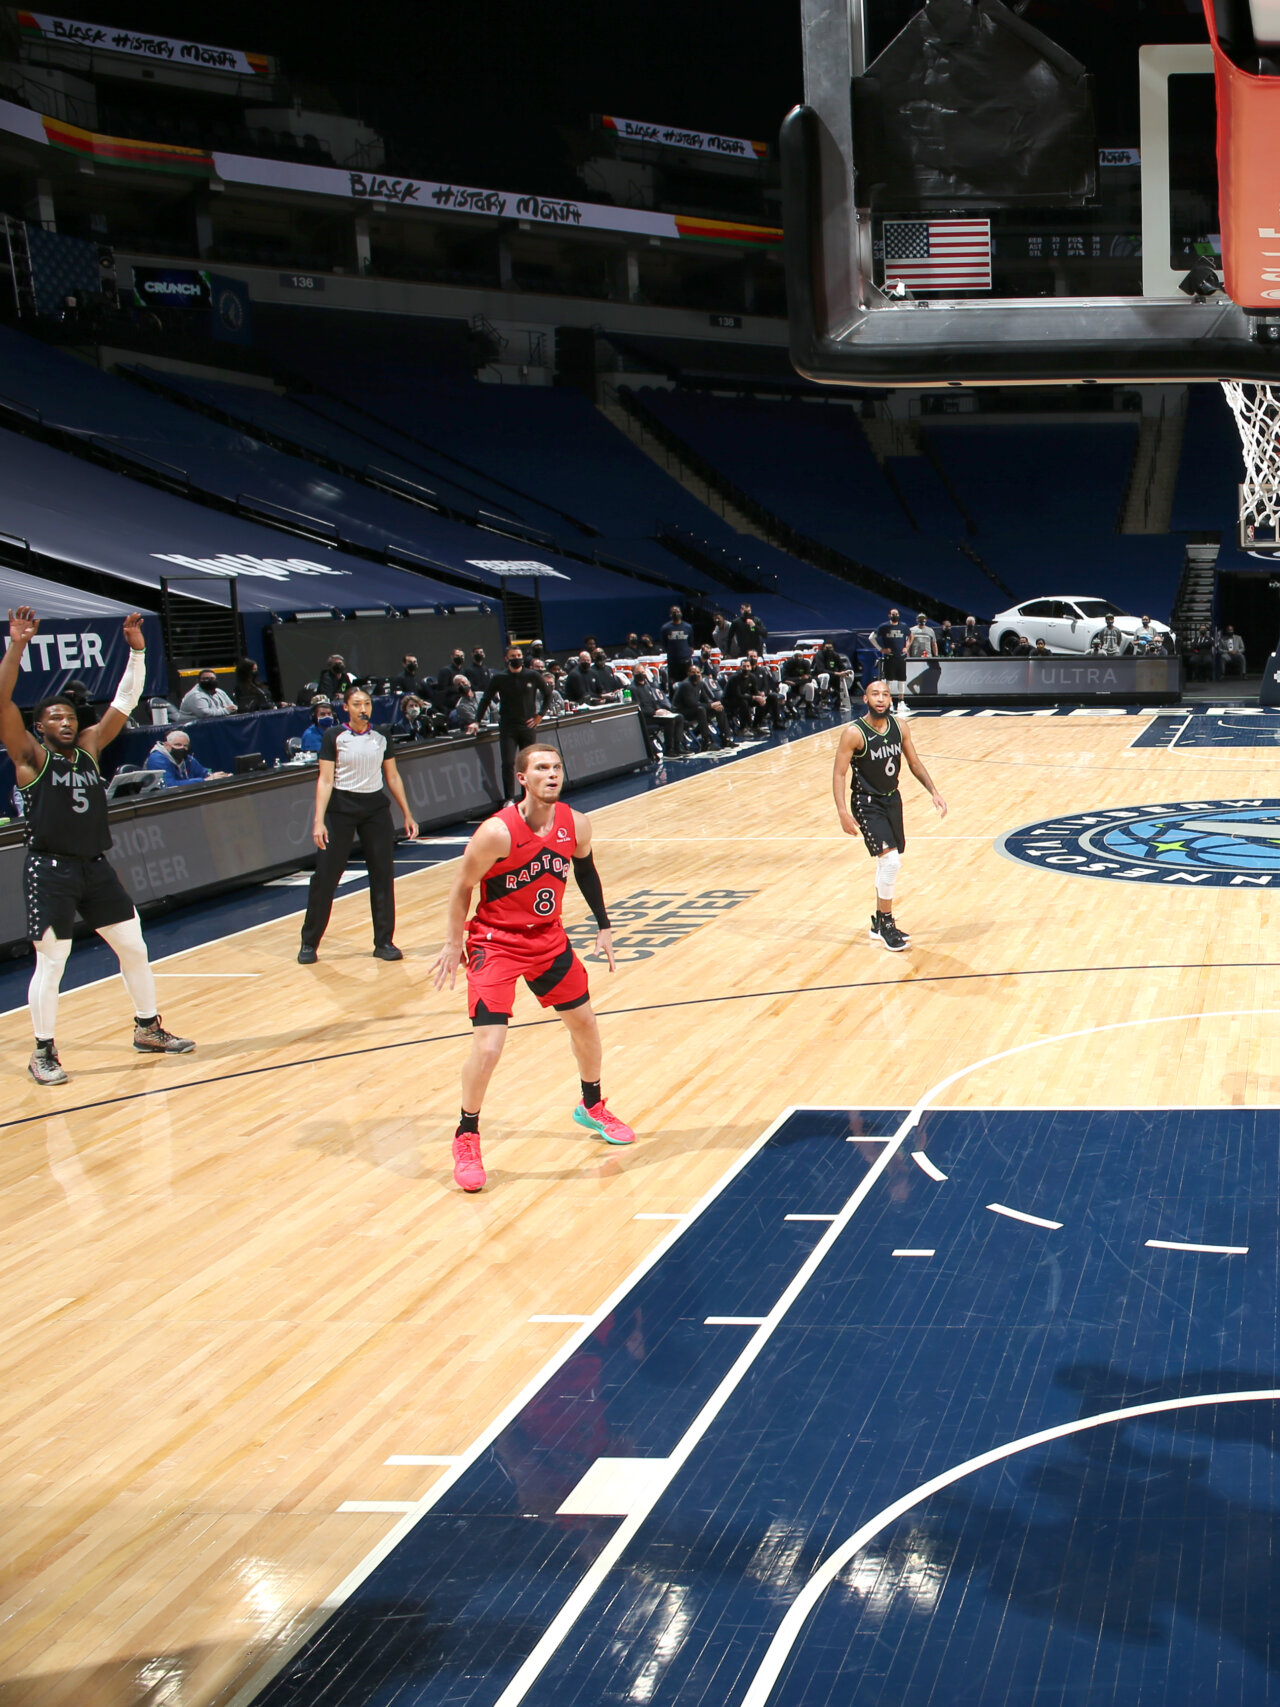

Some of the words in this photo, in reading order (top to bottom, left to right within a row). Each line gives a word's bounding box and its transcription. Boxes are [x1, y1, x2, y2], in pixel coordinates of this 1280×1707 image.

[144, 280, 202, 296] CRUNCH
[291, 276, 314, 289] 136
[1041, 668, 1118, 686] ULTRA
[870, 742, 903, 761] MINN
[885, 757, 896, 776] 6
[52, 769, 98, 787] MINN
[72, 788, 89, 813] 5
[131, 856, 190, 892] BEER
[506, 854, 570, 889] RAPTOR
[533, 888, 556, 916] 8
[563, 890, 689, 950] ARGET
[583, 889, 763, 963] CENTER
